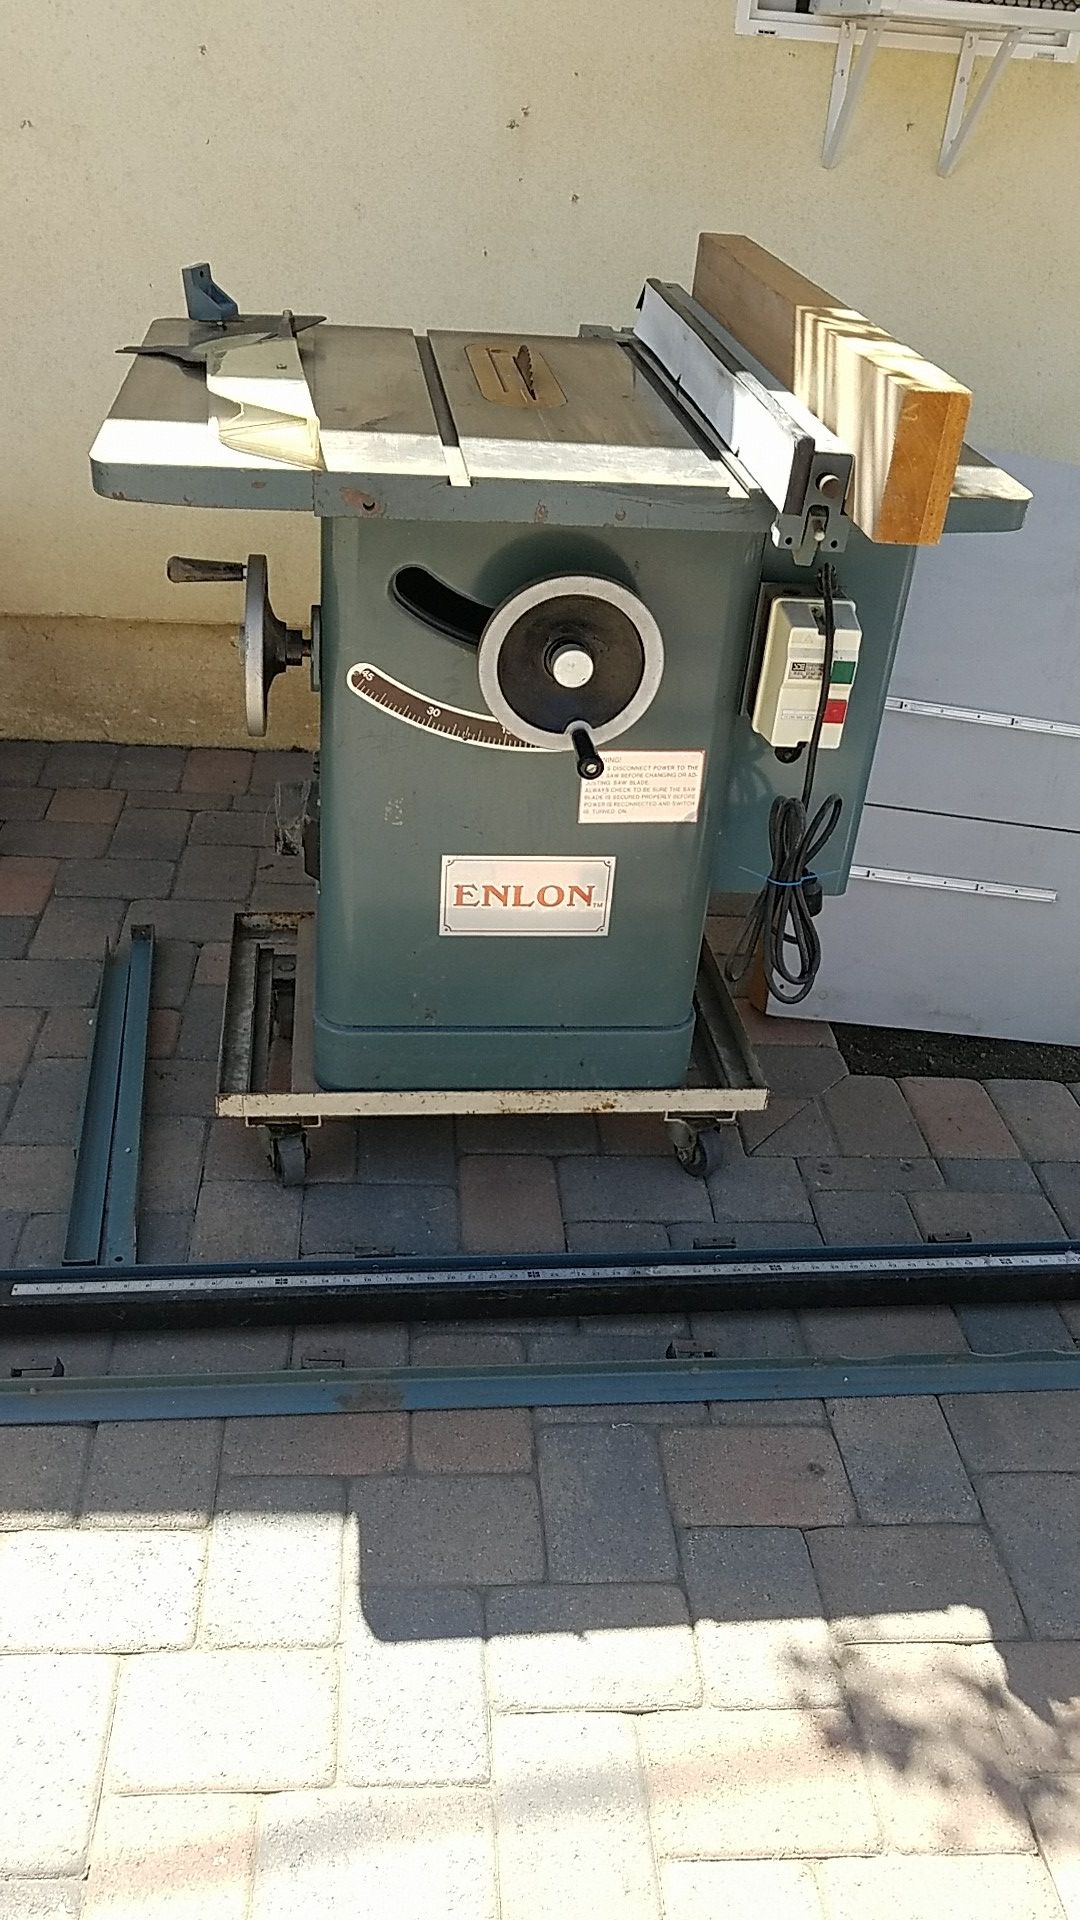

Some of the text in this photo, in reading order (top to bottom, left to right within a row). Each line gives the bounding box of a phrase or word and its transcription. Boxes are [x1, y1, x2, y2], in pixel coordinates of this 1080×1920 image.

[361, 670, 375, 682] 45
[426, 706, 441, 718] 30
[453, 884, 595, 907] ENLON
